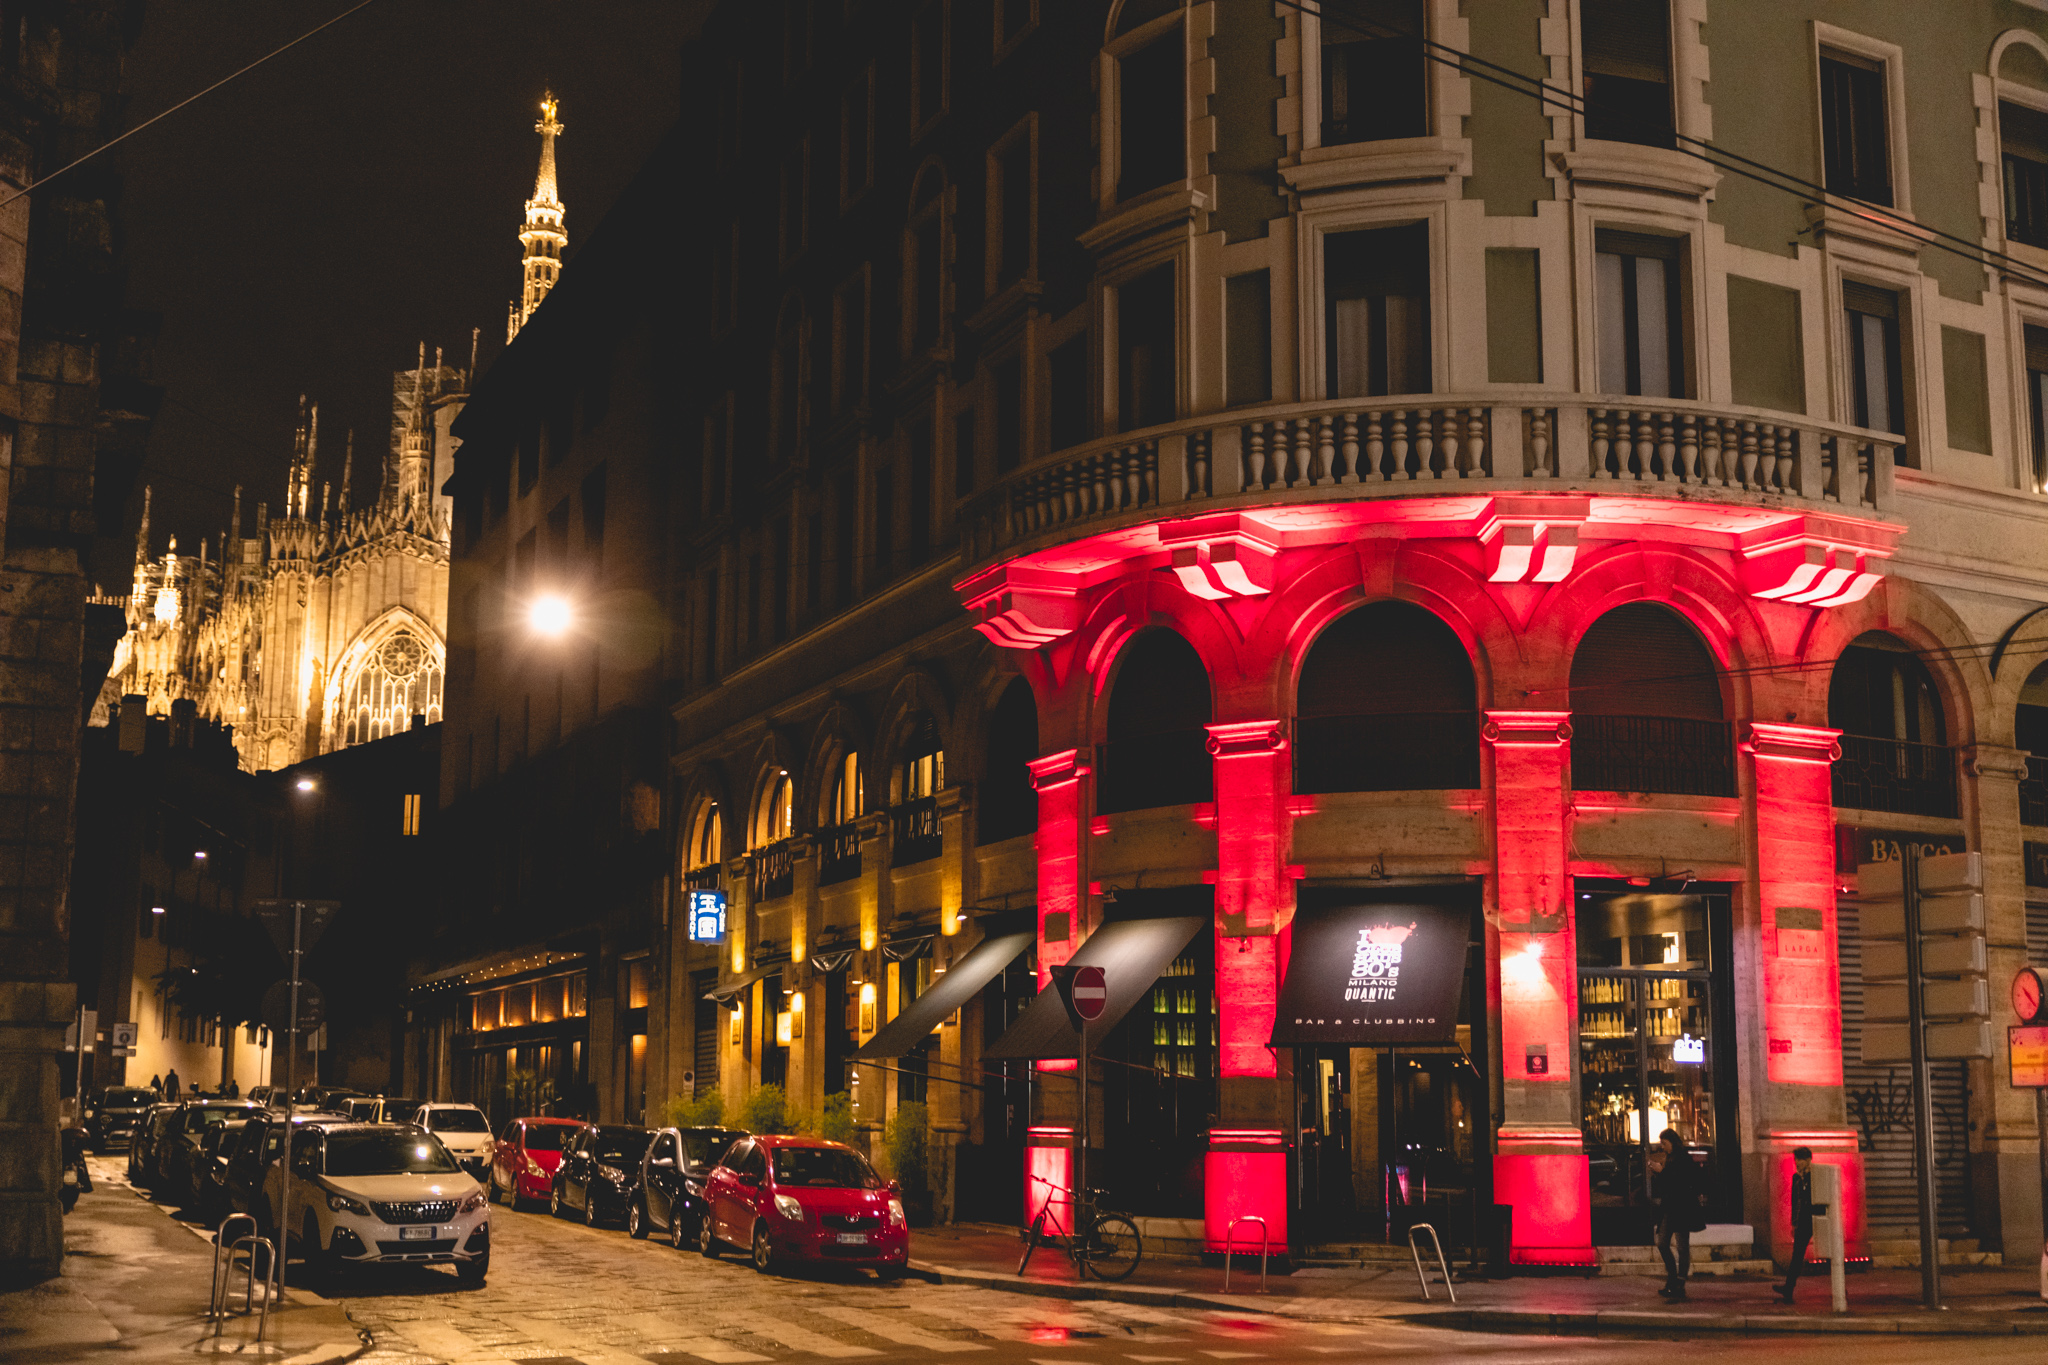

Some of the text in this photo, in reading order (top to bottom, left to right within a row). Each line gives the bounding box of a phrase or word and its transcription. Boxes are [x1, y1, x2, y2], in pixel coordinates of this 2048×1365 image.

[1348, 979, 1398, 987] MILANO
[1344, 987, 1397, 1001] QUANTIC
[1352, 1017, 1436, 1025] CLUBBING
